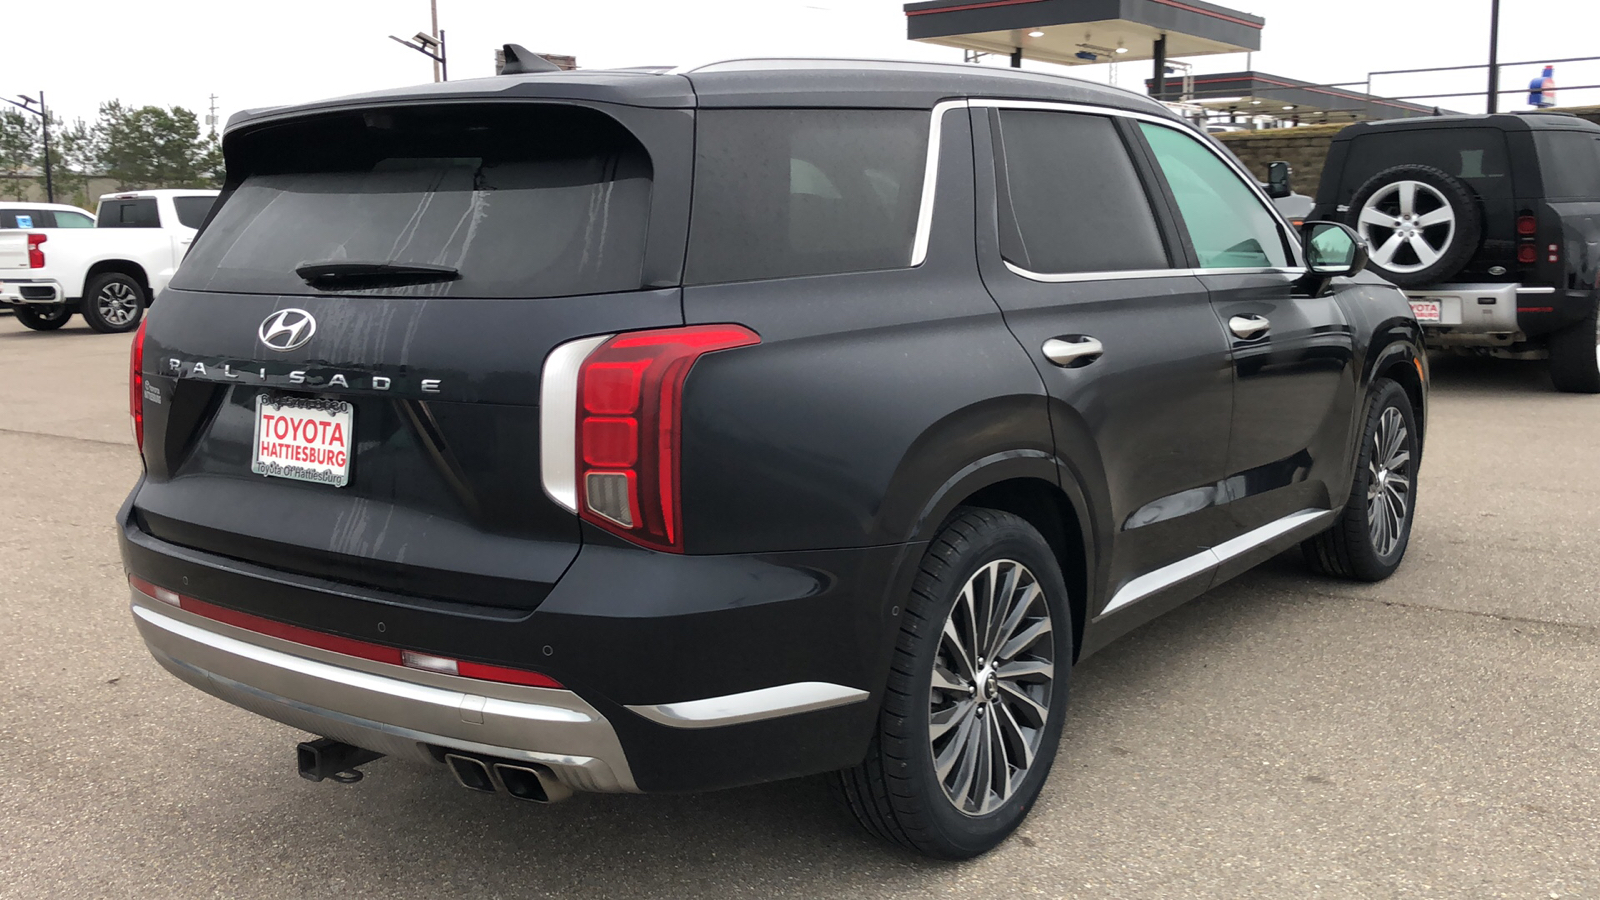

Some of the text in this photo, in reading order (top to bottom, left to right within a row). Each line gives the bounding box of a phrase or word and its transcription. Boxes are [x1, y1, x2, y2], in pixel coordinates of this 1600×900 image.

[169, 358, 442, 393] PALISADE
[263, 414, 345, 447] TOYOTA
[261, 441, 347, 468] HATTIESBURG
